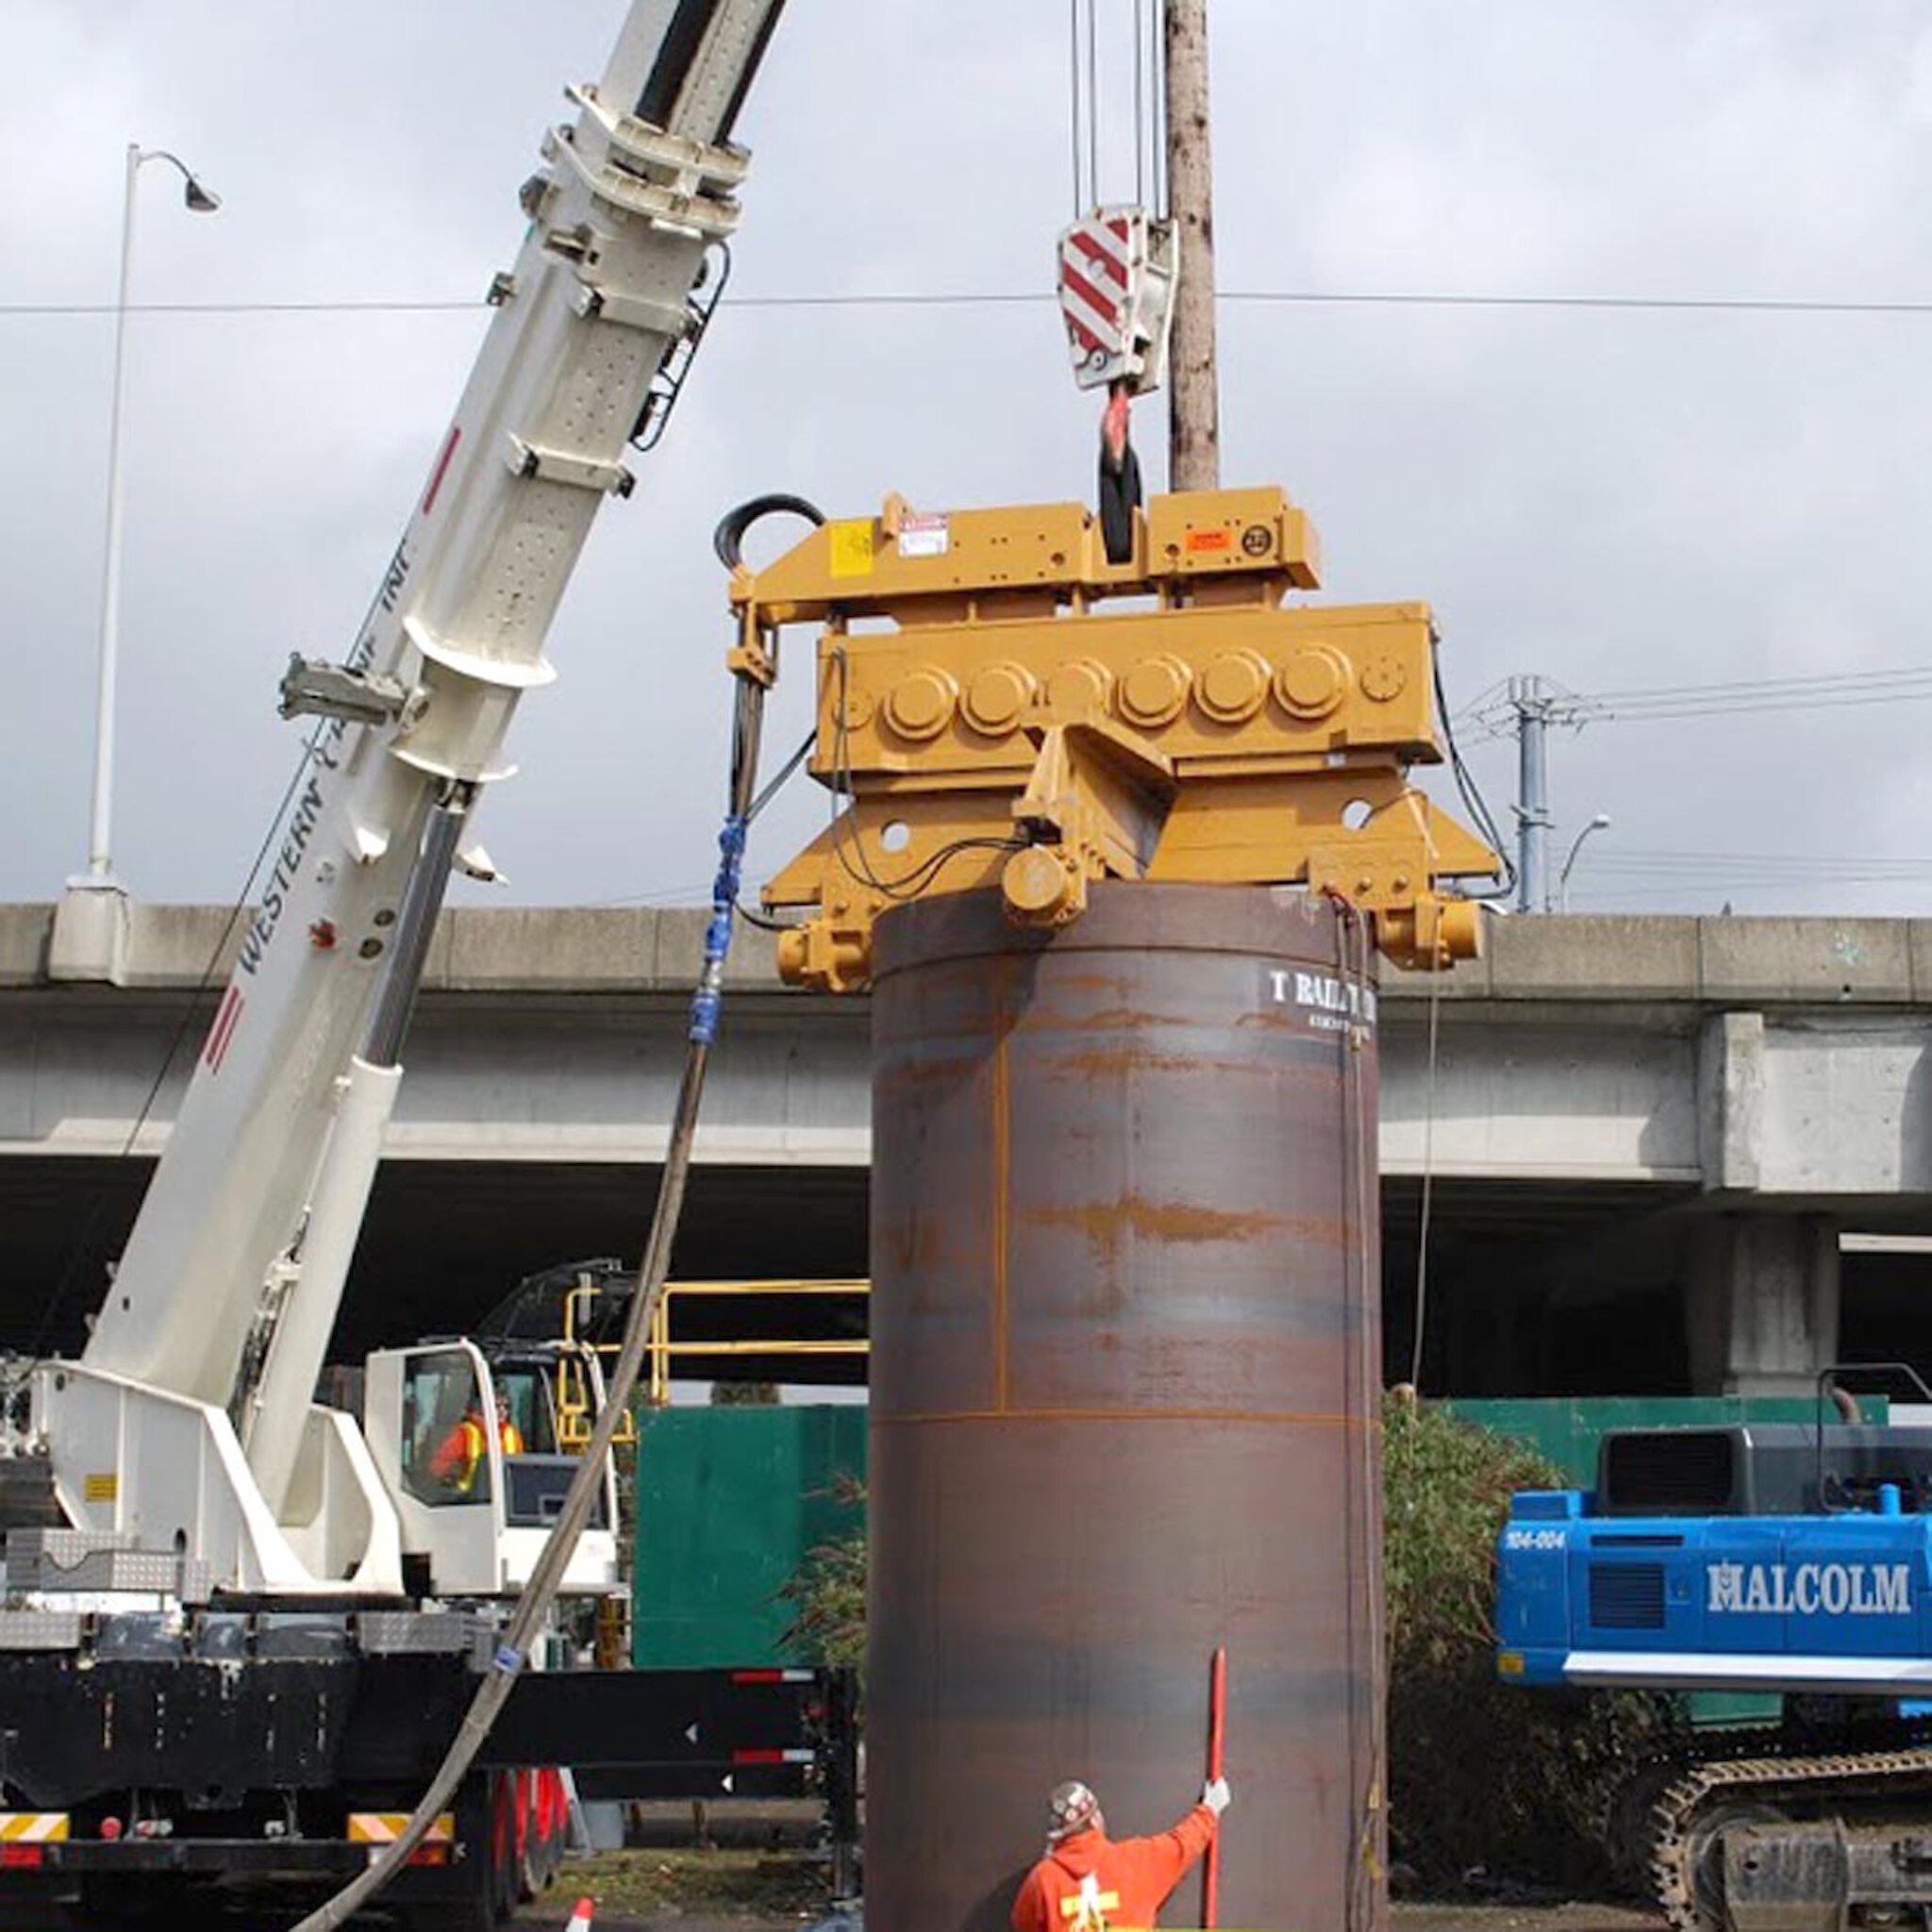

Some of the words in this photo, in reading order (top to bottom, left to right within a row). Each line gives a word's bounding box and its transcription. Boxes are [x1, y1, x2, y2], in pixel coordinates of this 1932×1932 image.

[240, 777, 324, 975] WESTERN
[1269, 970, 1290, 1003] T
[1707, 1561, 1911, 1614] MALCOLM
